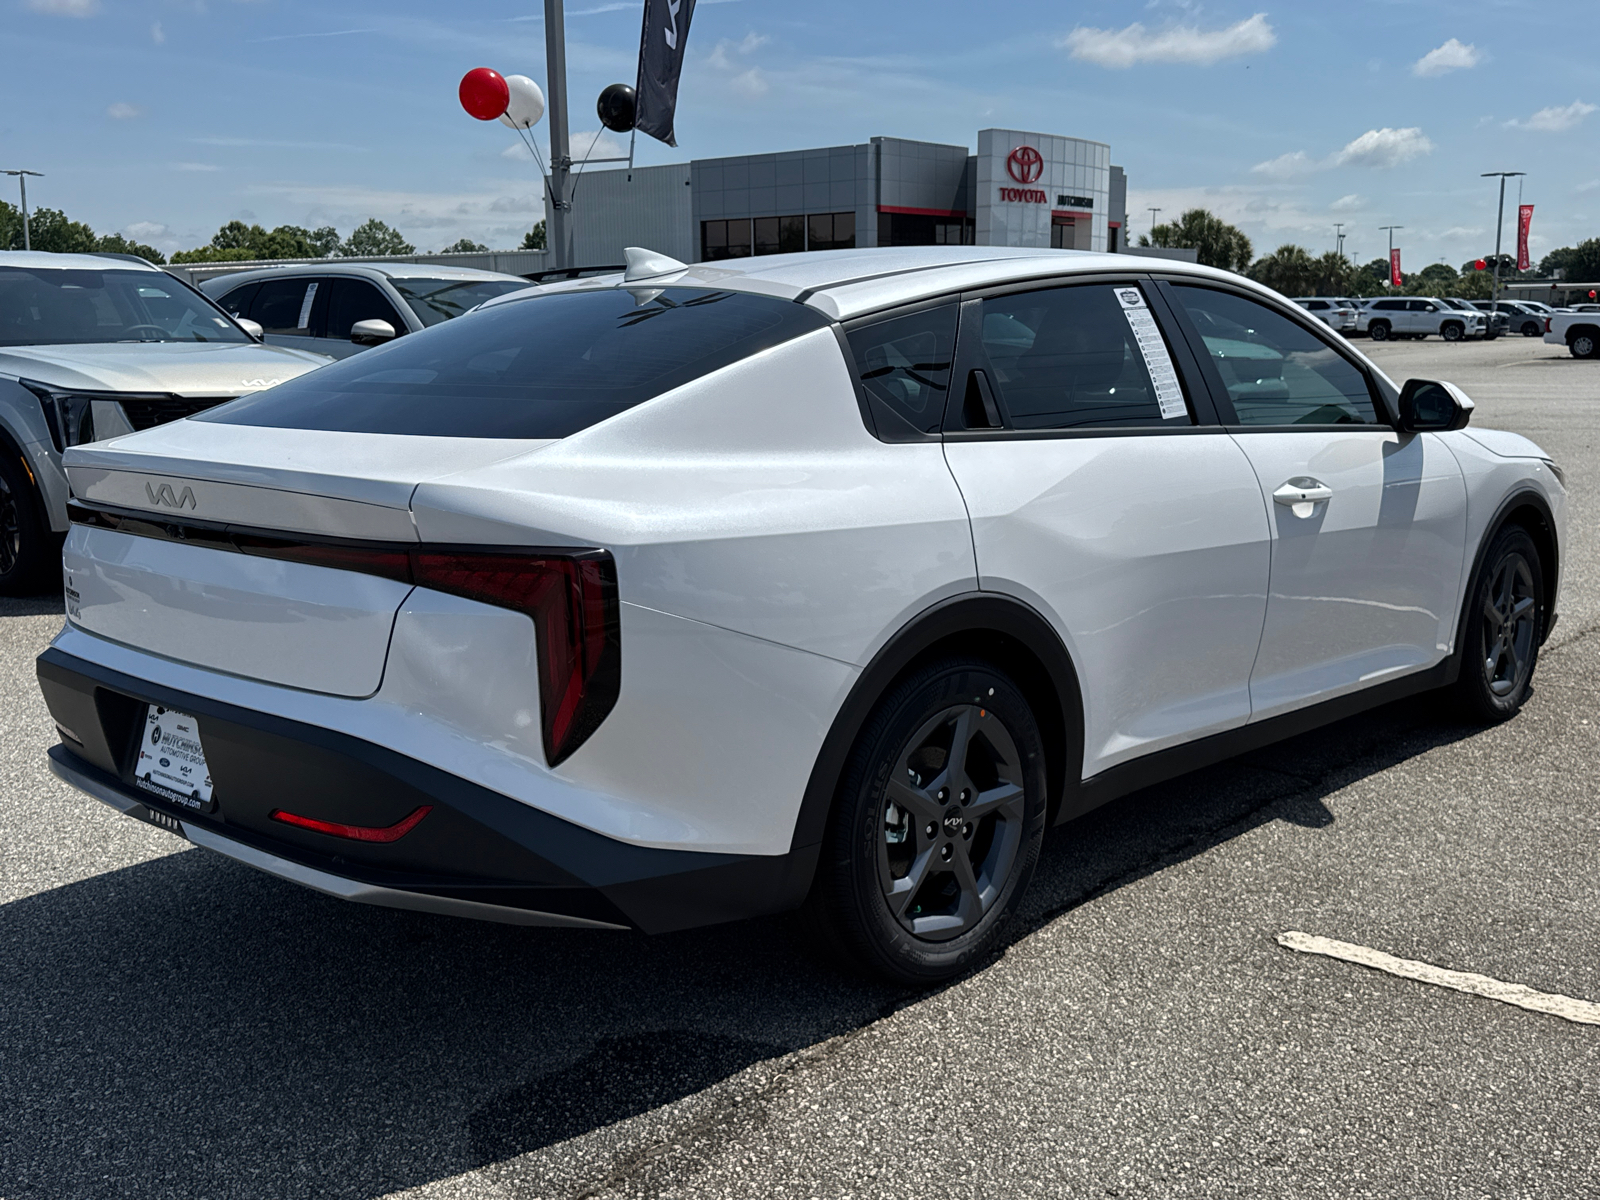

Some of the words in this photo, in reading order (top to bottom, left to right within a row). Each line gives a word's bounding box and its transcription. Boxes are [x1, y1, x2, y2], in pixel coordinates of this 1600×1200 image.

[999, 187, 1047, 204] TOYOTA
[145, 481, 197, 511] KIA
[161, 732, 204, 756] HUTCHINSO
[160, 746, 189, 761] AUTOMOTIVE
[190, 756, 206, 766] GROUP
[180, 766, 192, 774] KIA
[863, 760, 888, 859] SOLUS
